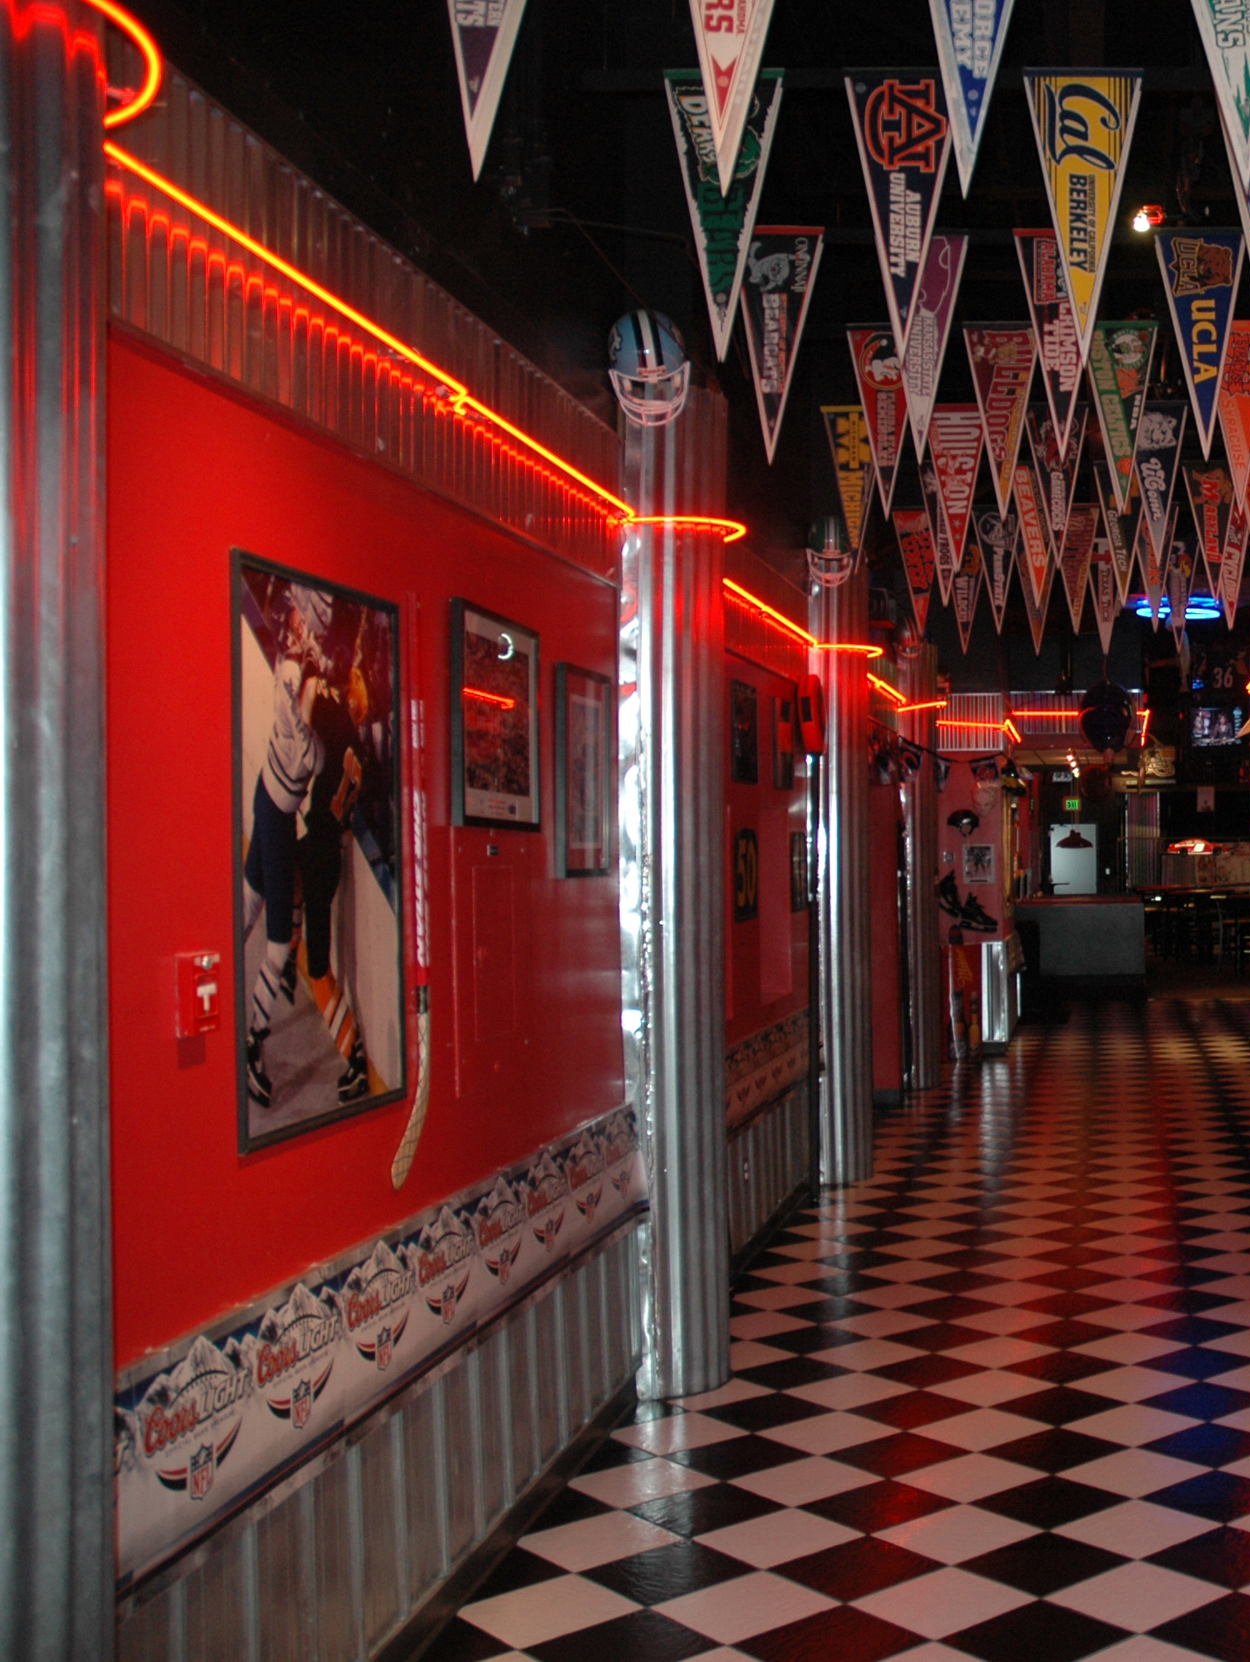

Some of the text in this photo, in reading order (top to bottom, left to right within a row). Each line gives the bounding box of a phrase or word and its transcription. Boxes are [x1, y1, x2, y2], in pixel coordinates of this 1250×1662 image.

[1043, 82, 1121, 171] Cal
[889, 172, 907, 278] UNIVERSITY
[904, 189, 922, 263] AUBURN
[1069, 174, 1088, 272] BERKELEY
[1040, 242, 1056, 299] ALABAMA
[1176, 242, 1199, 293] UCLA
[760, 292, 780, 394] BEARCATS
[909, 316, 922, 394] UNIVERSITY
[1043, 319, 1060, 372] TIDE
[1190, 299, 1218, 384] UCLA
[1129, 394, 1141, 430] NBA
[1223, 399, 1247, 469] SYRACUSE
[837, 470, 865, 549] MICHIGAN
[1015, 469, 1046, 568] BEAVERS
[1140, 457, 1167, 521] UConn
[1202, 478, 1222, 563] MARYLAND
[939, 537, 951, 565] FROGS
[1106, 510, 1129, 573] GEORGIA TECH
[1221, 546, 1240, 602] CYCLONES
[1212, 667, 1234, 690] 36
[737, 838, 757, 908] 50
[346, 1291, 380, 1331] Coors
[256, 1342, 298, 1388] Coors
[297, 1315, 341, 1362] LIGHT
[145, 1404, 197, 1458] Coors
[196, 1366, 251, 1424] LIGHT
[293, 1397, 311, 1426] NFL
[192, 1466, 212, 1497] NFL
